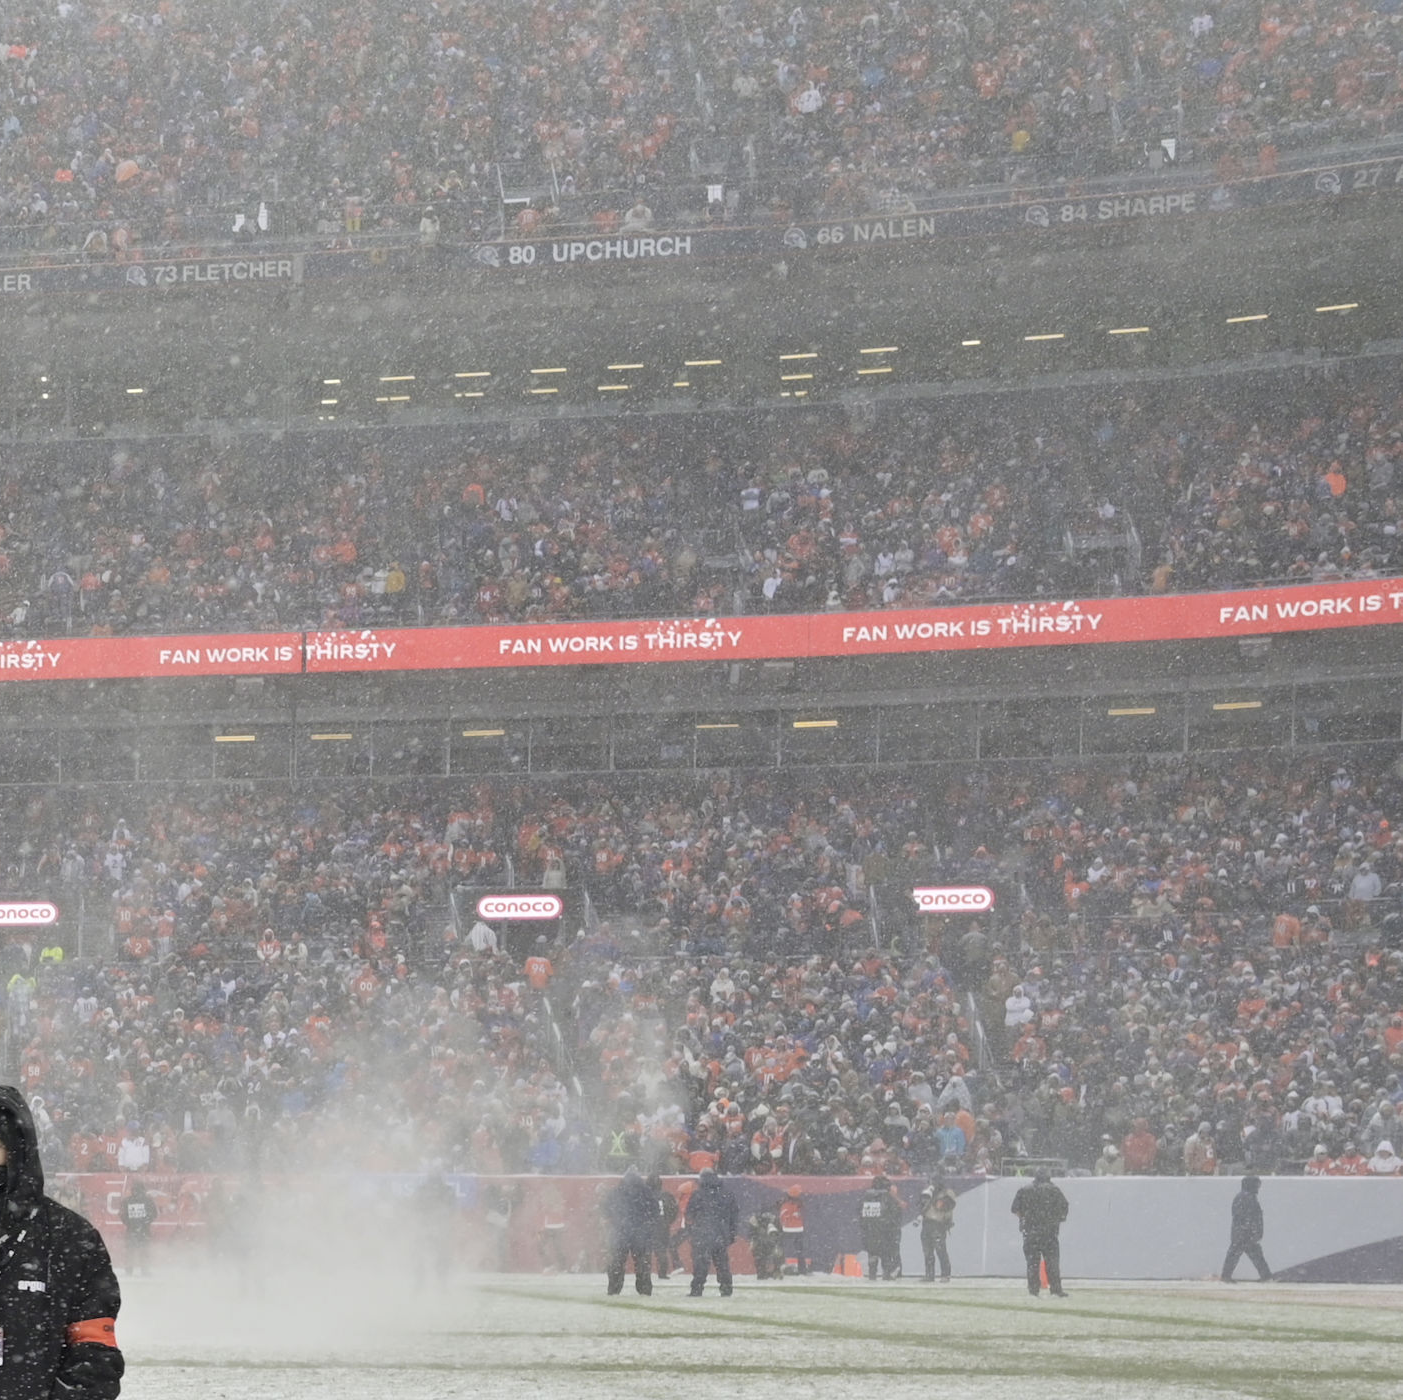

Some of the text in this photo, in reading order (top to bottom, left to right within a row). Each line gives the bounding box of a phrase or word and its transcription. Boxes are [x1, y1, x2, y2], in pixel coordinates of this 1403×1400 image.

[1061, 192, 1196, 222] 84 SHARPE
[817, 217, 935, 244] 66 NALEN
[509, 236, 691, 265] 80 UPCHURCH
[153, 260, 292, 285] 73 FLETCHER
[1219, 605, 1268, 623] FAN
[1276, 597, 1352, 618] WORK
[1359, 595, 1382, 611] IS
[843, 612, 1102, 642] FAN WORK IS THIRSTY
[159, 642, 396, 664] FAN WORK IS THIRSTY
[499, 630, 742, 654] FAN WORK IS THIRSTY
[484, 902, 555, 912] conoco
[914, 893, 986, 905] onoco
[120, 910, 130, 921] 10
[135, 943, 142, 953] 2
[936, 1076, 943, 1088] 2
[81, 1143, 88, 1155] 2
[107, 1143, 116, 1154] 10
